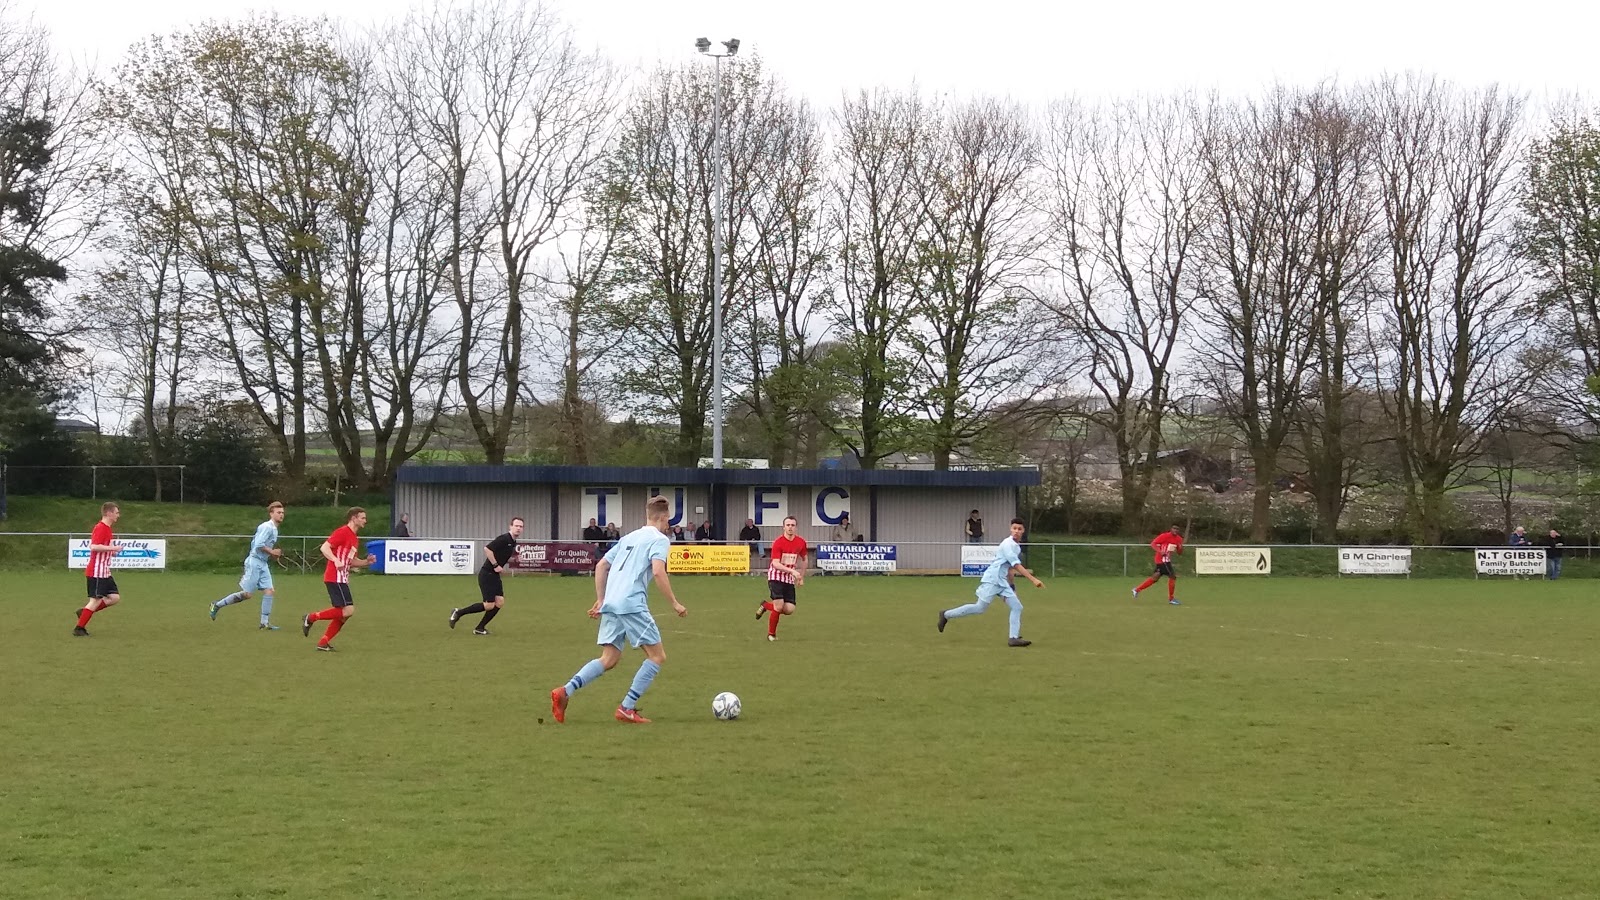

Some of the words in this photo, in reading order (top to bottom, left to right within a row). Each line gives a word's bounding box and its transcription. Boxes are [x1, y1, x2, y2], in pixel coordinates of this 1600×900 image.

[585, 487, 618, 526] T
[651, 487, 684, 526] U
[754, 487, 782, 525] F
[815, 486, 850, 525] C
[515, 544, 546, 553] Cathedral
[820, 545, 866, 553] RICHARD
[868, 545, 894, 553] LANE
[389, 549, 443, 566] Respect
[619, 546, 634, 571] 7
[670, 552, 704, 560] CROWN
[828, 552, 886, 560] TRANSPORT
[1478, 552, 1499, 560] N.T
[1503, 552, 1544, 560] GIBBS
